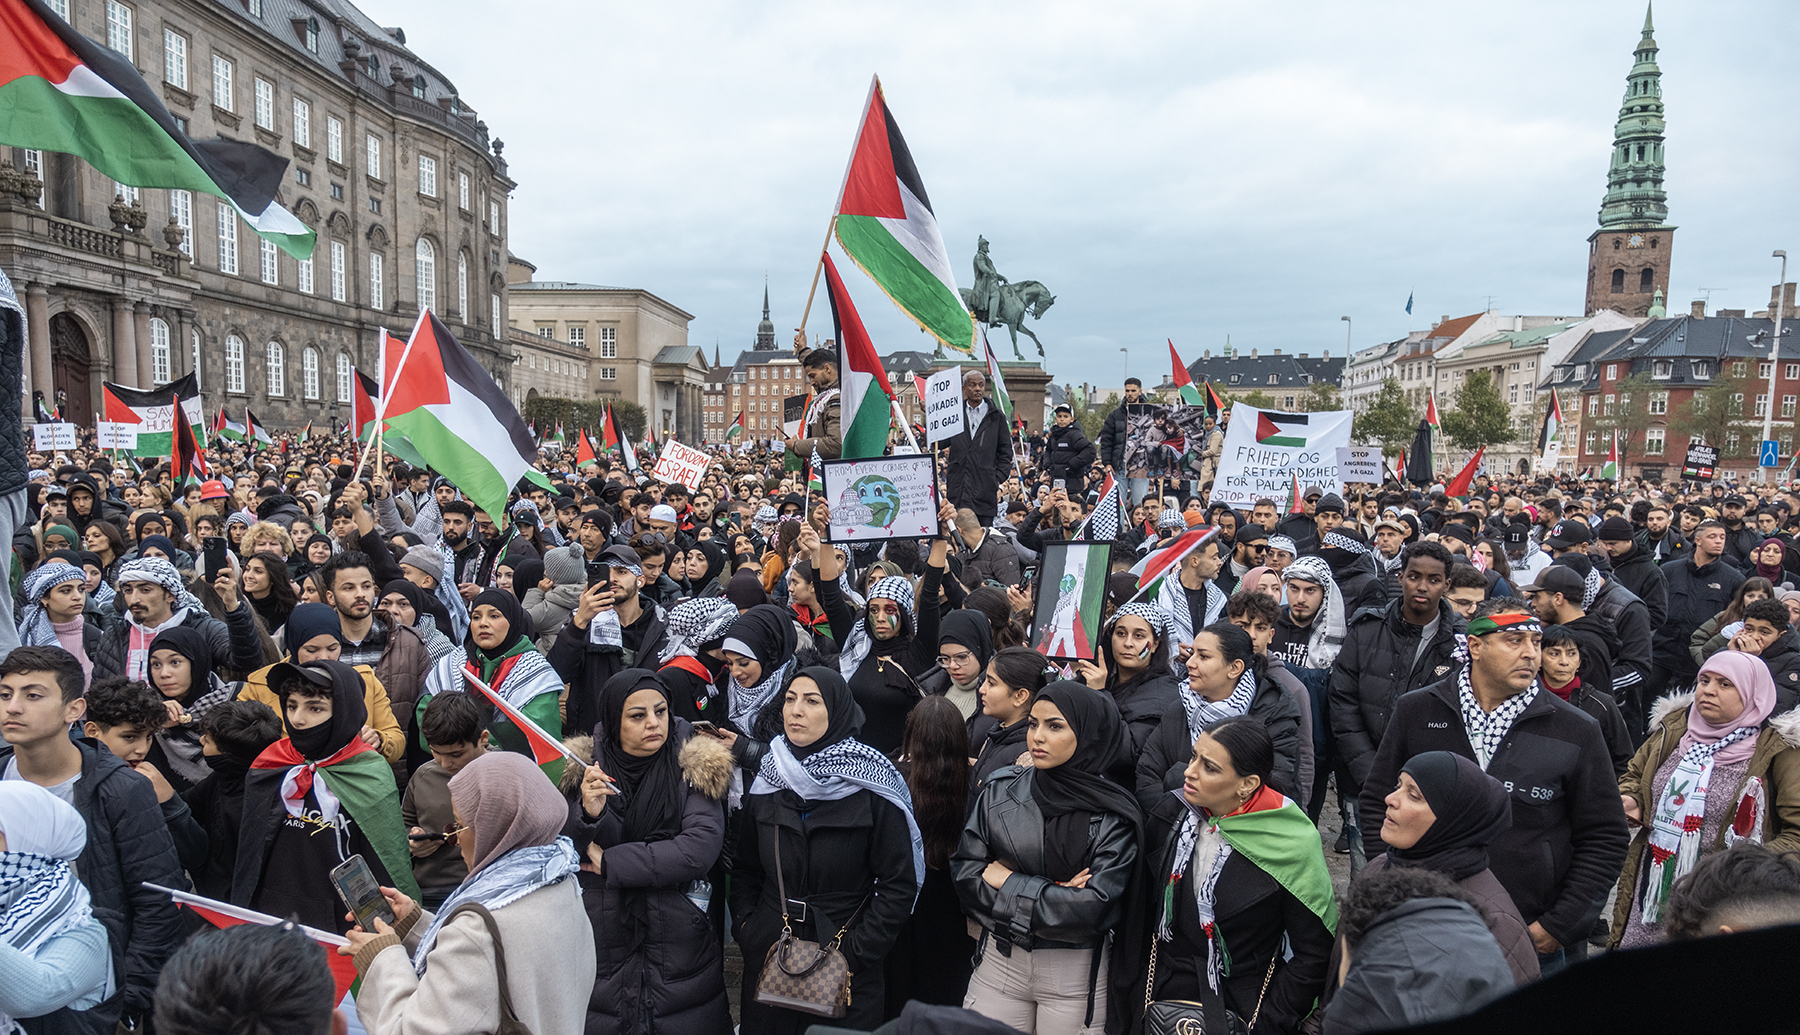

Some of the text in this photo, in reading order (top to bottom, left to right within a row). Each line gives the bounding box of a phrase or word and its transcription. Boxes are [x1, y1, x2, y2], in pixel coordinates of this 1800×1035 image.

[932, 380, 950, 395] STOP
[146, 407, 174, 420] SAV
[927, 396, 959, 416] LOKADEN
[929, 413, 960, 431] OD GAZA
[670, 443, 709, 469] FORDØM
[1236, 446, 1320, 467] FRIHED OG
[654, 457, 698, 490] ISRAEL
[828, 460, 931, 477] FROM EVERY CORNER OF THE
[1243, 465, 1339, 478] RETFÆRDIGHED
[891, 473, 917, 483] WORLD:
[1226, 476, 1336, 491] FOR PALÆSTINA
[1214, 489, 1245, 501] STOP
[1272, 651, 1307, 667] ORTH
[1427, 721, 1448, 729] HALO
[1503, 781, 1514, 793] B
[1530, 786, 1554, 801] 538
